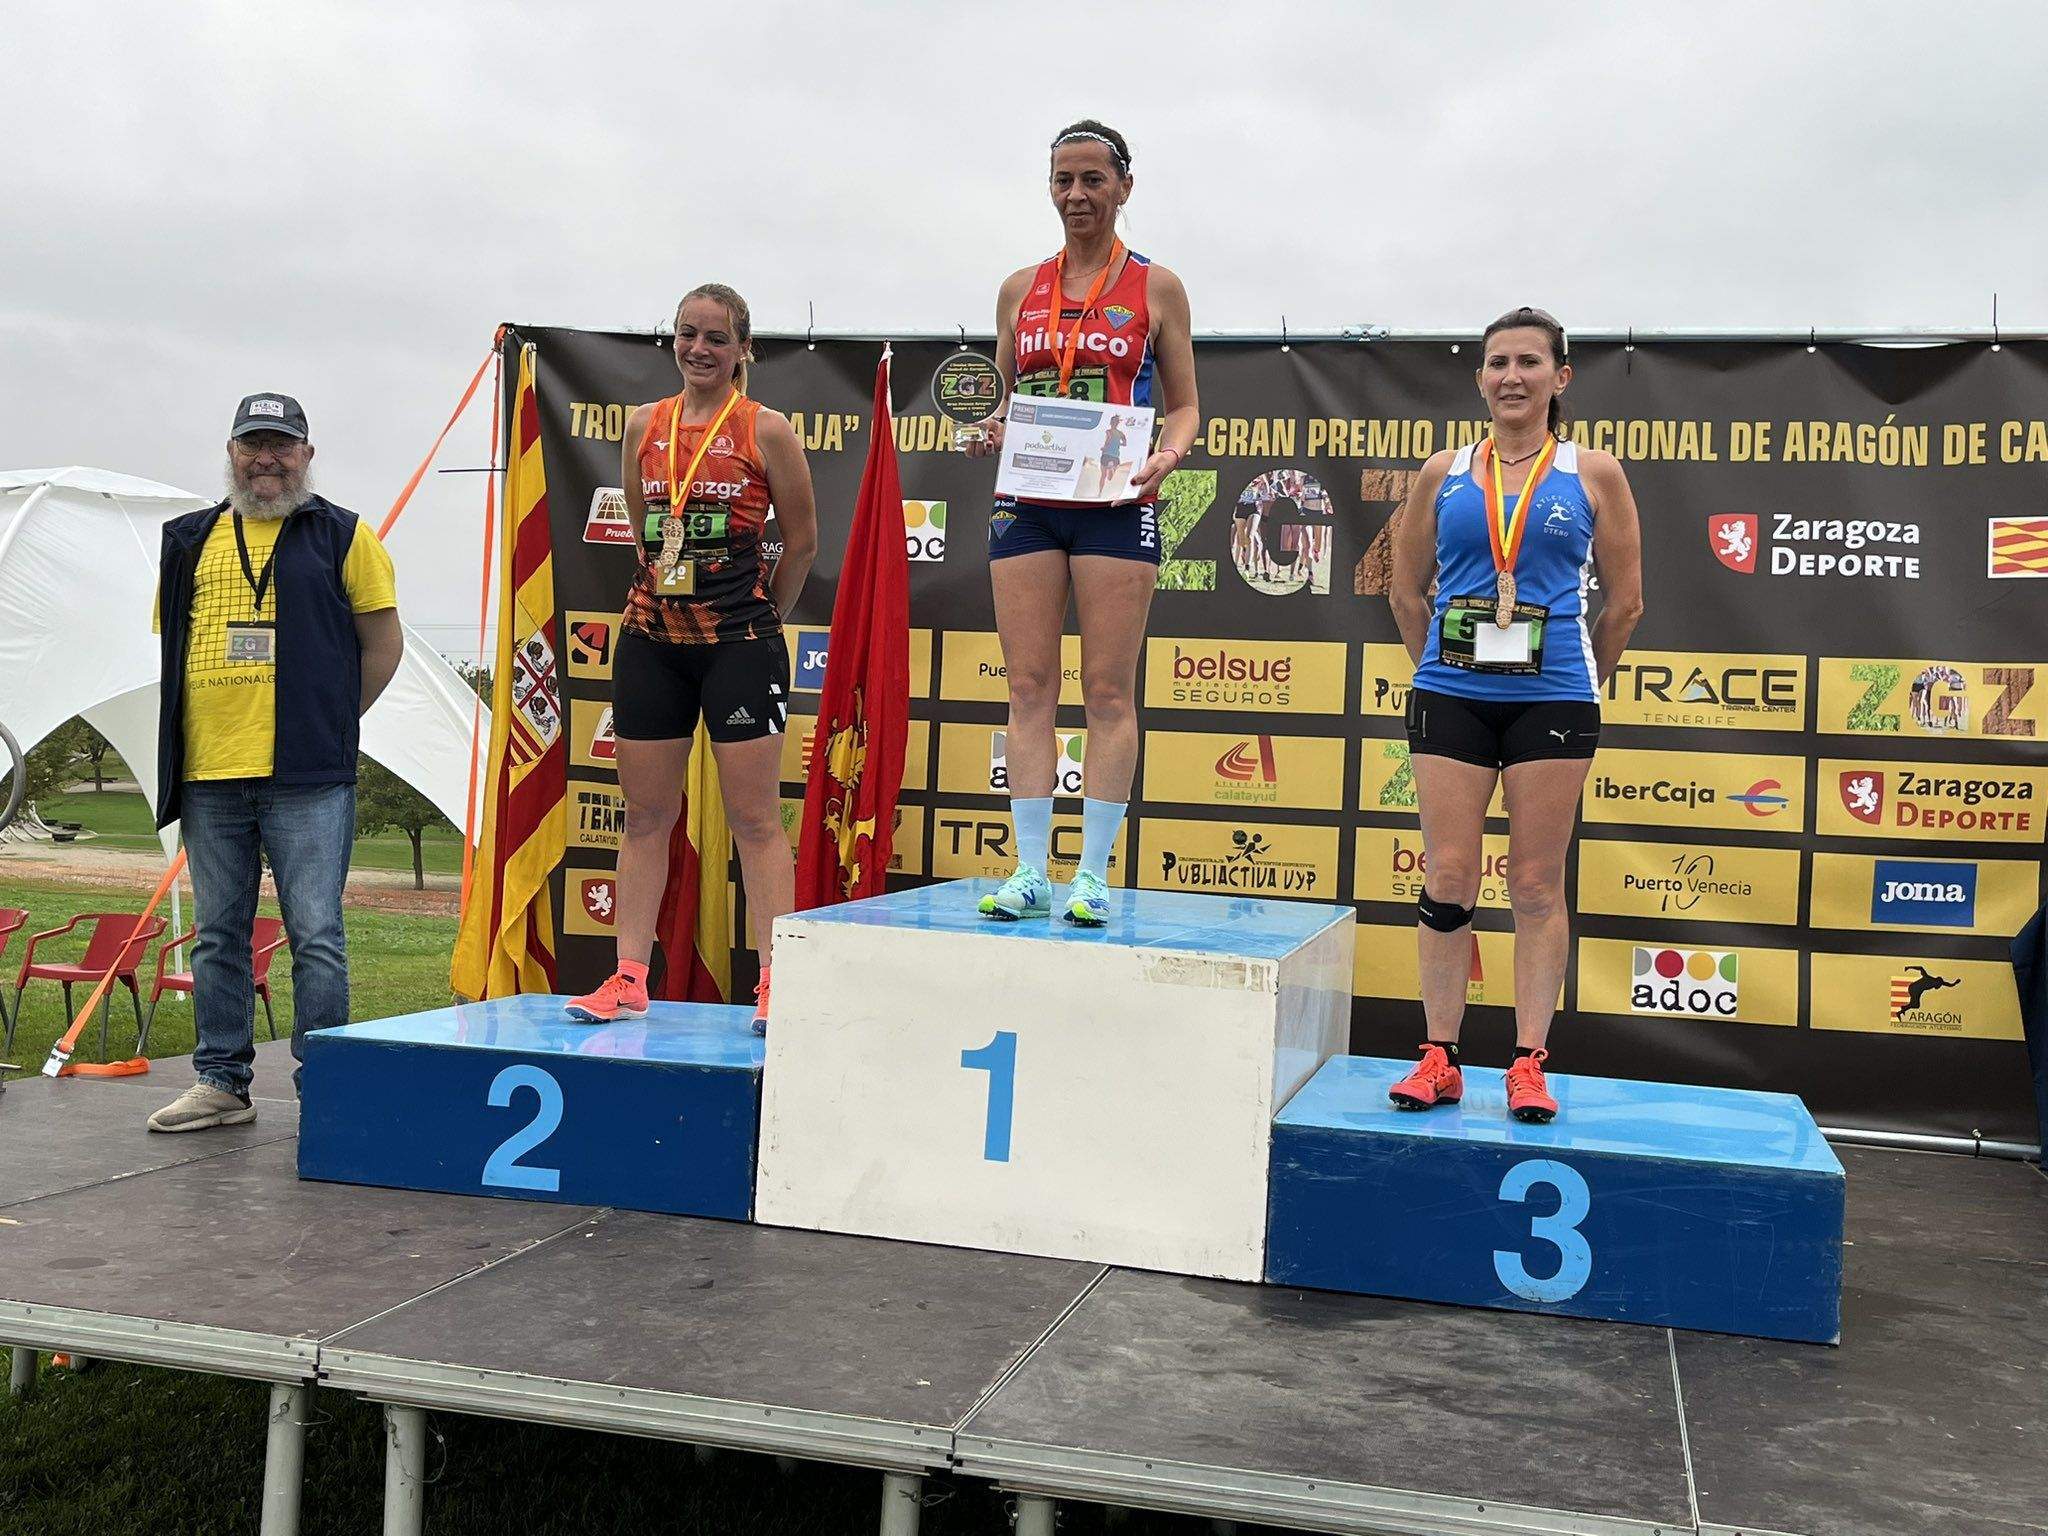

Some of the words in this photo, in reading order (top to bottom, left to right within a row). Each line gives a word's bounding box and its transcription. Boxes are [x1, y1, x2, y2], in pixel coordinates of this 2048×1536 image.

[569, 402, 638, 442] TRO
[1307, 418, 1433, 460] PREMIO
[1729, 420, 1772, 462] DE
[1782, 414, 1929, 467] ARAGÓN
[1942, 422, 1988, 466] DE
[1771, 513, 1920, 549] Zaragoza
[1770, 546, 1920, 579] DEPORTE
[1173, 645, 1292, 683] belsué
[1172, 689, 1290, 706] SEGUROS
[1721, 704, 1760, 713] TRAINING
[1762, 705, 1796, 713] CENTER
[1846, 664, 2036, 737] ZGZ
[726, 717, 756, 725] adidas
[1643, 713, 1737, 726] TENERIFE
[1214, 790, 1277, 803] calatayud
[1594, 778, 1715, 810] iberCaja
[1897, 771, 2034, 807] Zaragoza
[1896, 801, 2031, 832] DEPORTE
[1624, 874, 1683, 892] Puerto
[1687, 878, 1752, 896] Venecia
[1631, 980, 1738, 1016] adoc
[1908, 1012, 1962, 1024] ARAGÓN
[961, 1031, 1017, 1162] 1
[482, 1064, 565, 1194] 2
[1493, 1158, 1592, 1303] 3
